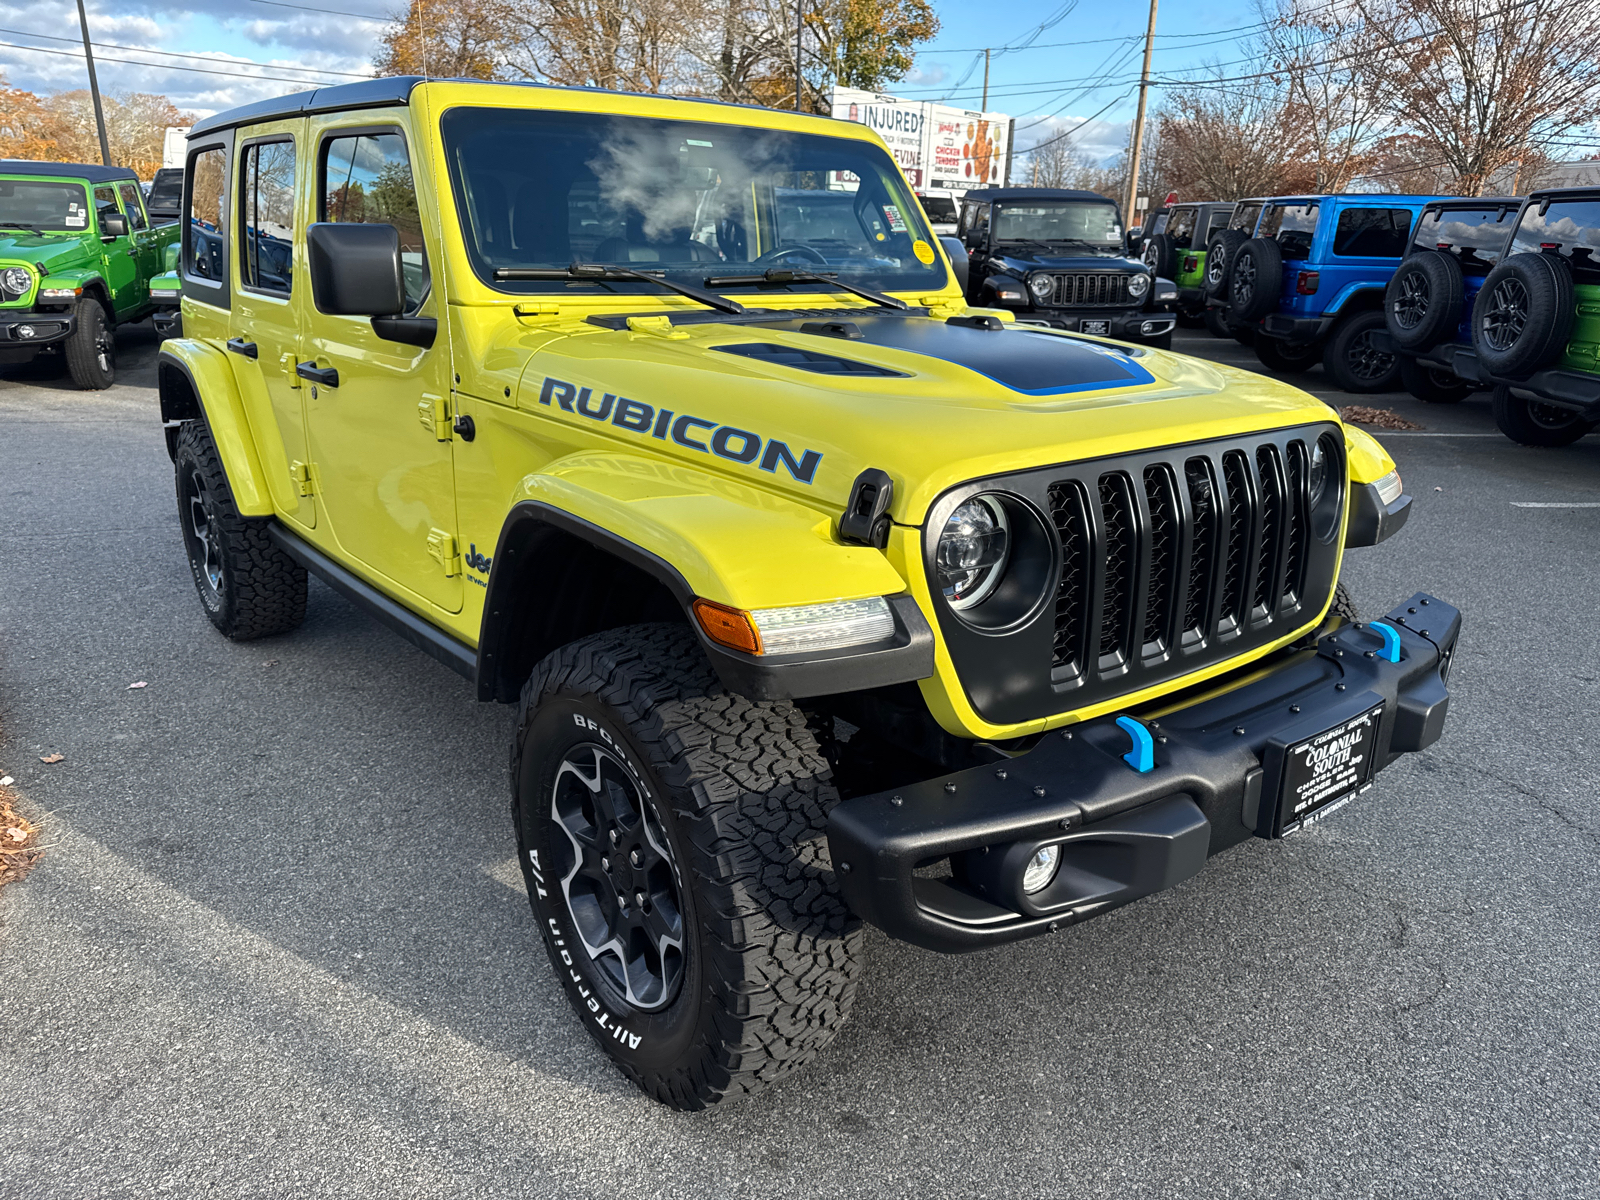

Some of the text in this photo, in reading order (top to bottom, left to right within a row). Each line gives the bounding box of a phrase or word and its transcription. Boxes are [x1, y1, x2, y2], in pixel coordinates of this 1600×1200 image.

[864, 105, 924, 134] INJURED?
[894, 148, 921, 166] EVINE
[935, 145, 960, 156] CHICKEN
[935, 156, 959, 167] TENDERS
[539, 376, 824, 486] RUBICON
[465, 543, 492, 575] Jee
[1305, 728, 1362, 767] COLONIAL
[1314, 726, 1346, 746] COLONIAL
[1313, 747, 1352, 778] SOUTH
[1296, 764, 1344, 793] CHRYSLER
[1301, 767, 1356, 800] DODGE RAM
[529, 849, 642, 1050] All-Terrain T/A
